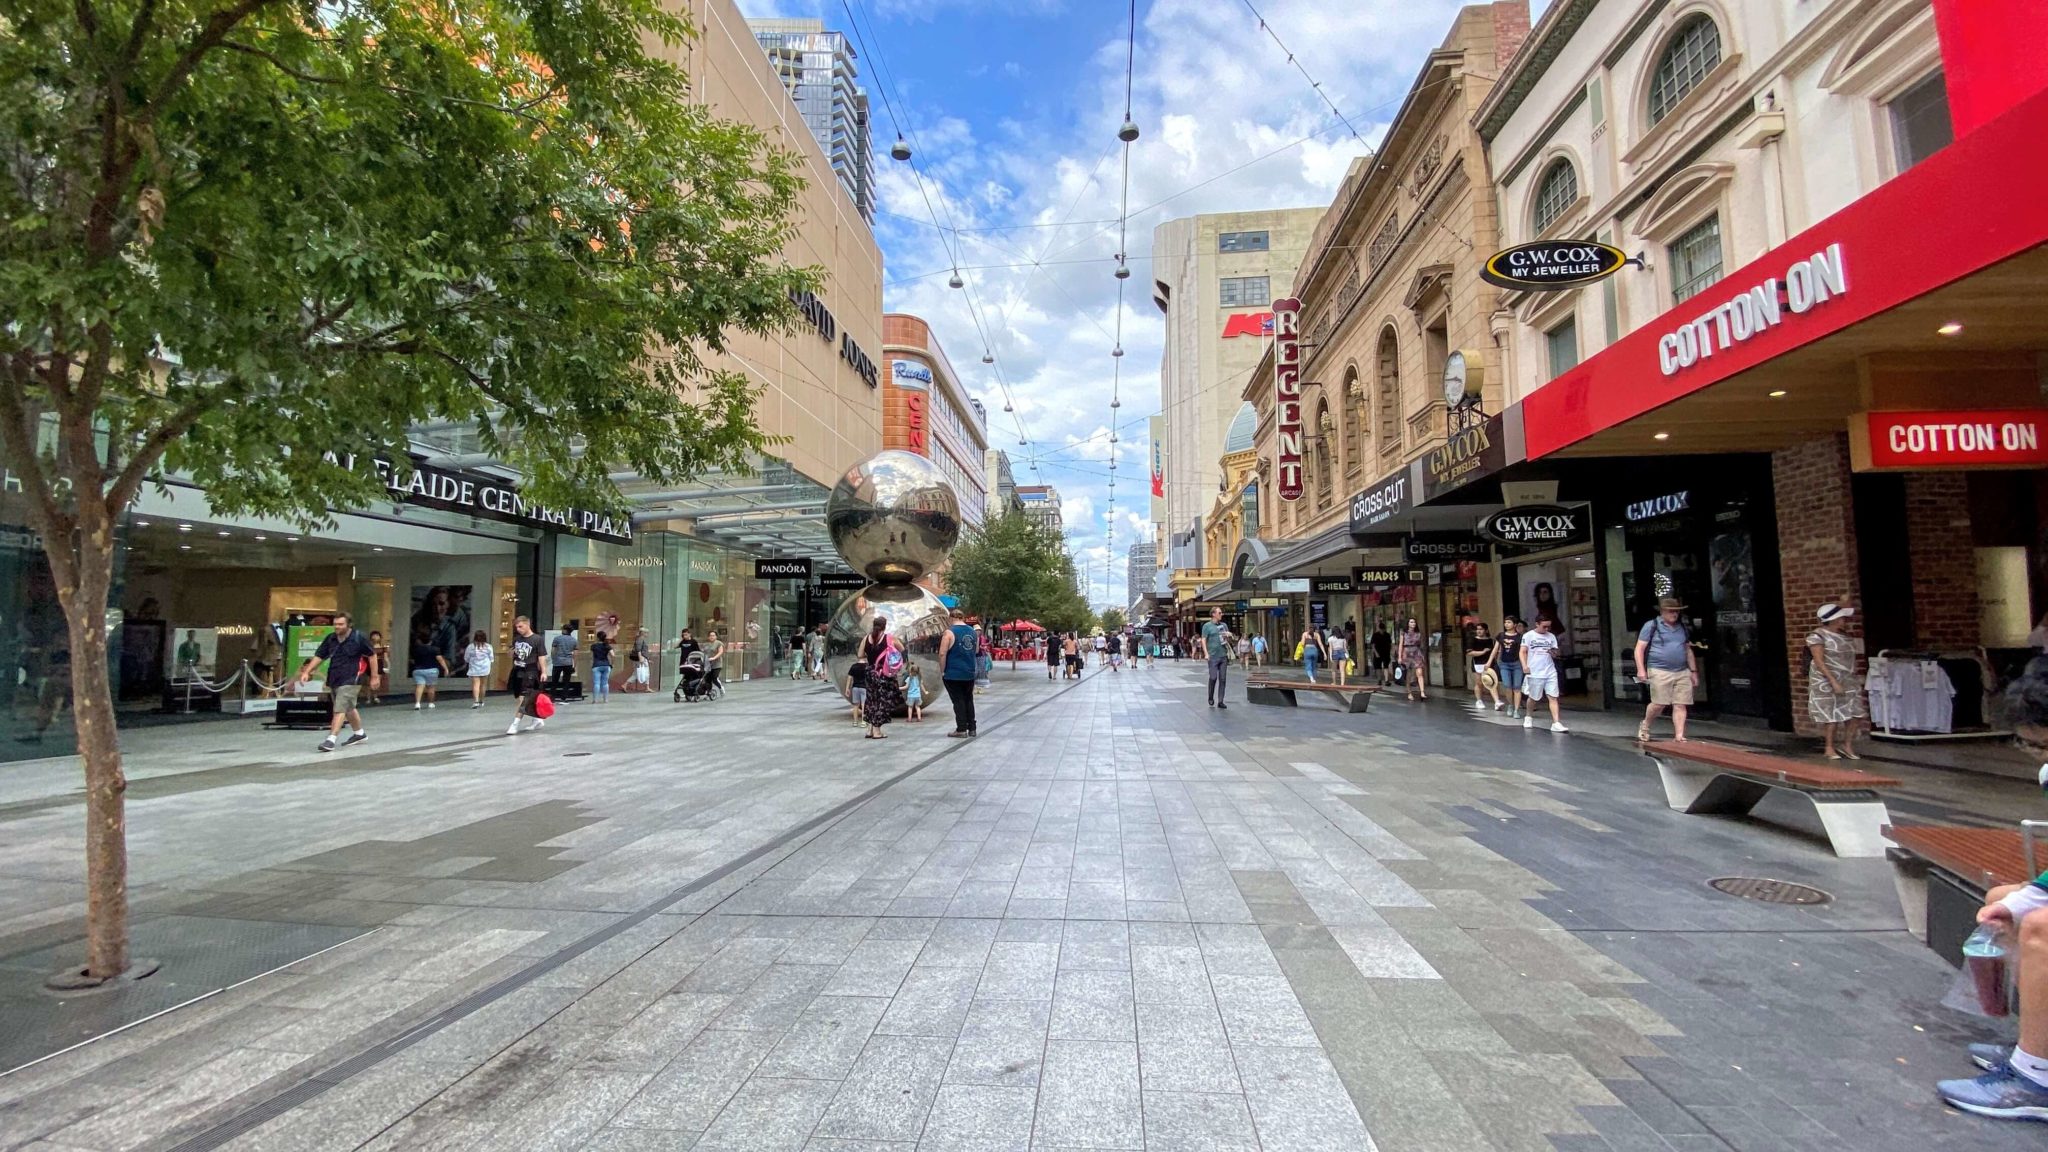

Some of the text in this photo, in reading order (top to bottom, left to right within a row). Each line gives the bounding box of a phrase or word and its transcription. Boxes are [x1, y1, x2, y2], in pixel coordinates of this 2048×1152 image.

[1509, 246, 1600, 266] G.W. COX
[1512, 263, 1600, 277] MY JEWELLER
[840, 331, 878, 391] JONES
[1276, 309, 1301, 487] REGENT
[908, 393, 923, 455] CEN
[1455, 421, 1491, 462] COX
[1353, 478, 1405, 521] CROSS CUT
[1656, 491, 1690, 514] COX
[1496, 515, 1576, 532] G.W. COX
[1505, 530, 1568, 541] MY JEWELLER
[1410, 543, 1485, 554] CROSS CUT
[1362, 571, 1399, 581] SHADES
[1318, 583, 1350, 591] SHIELS
